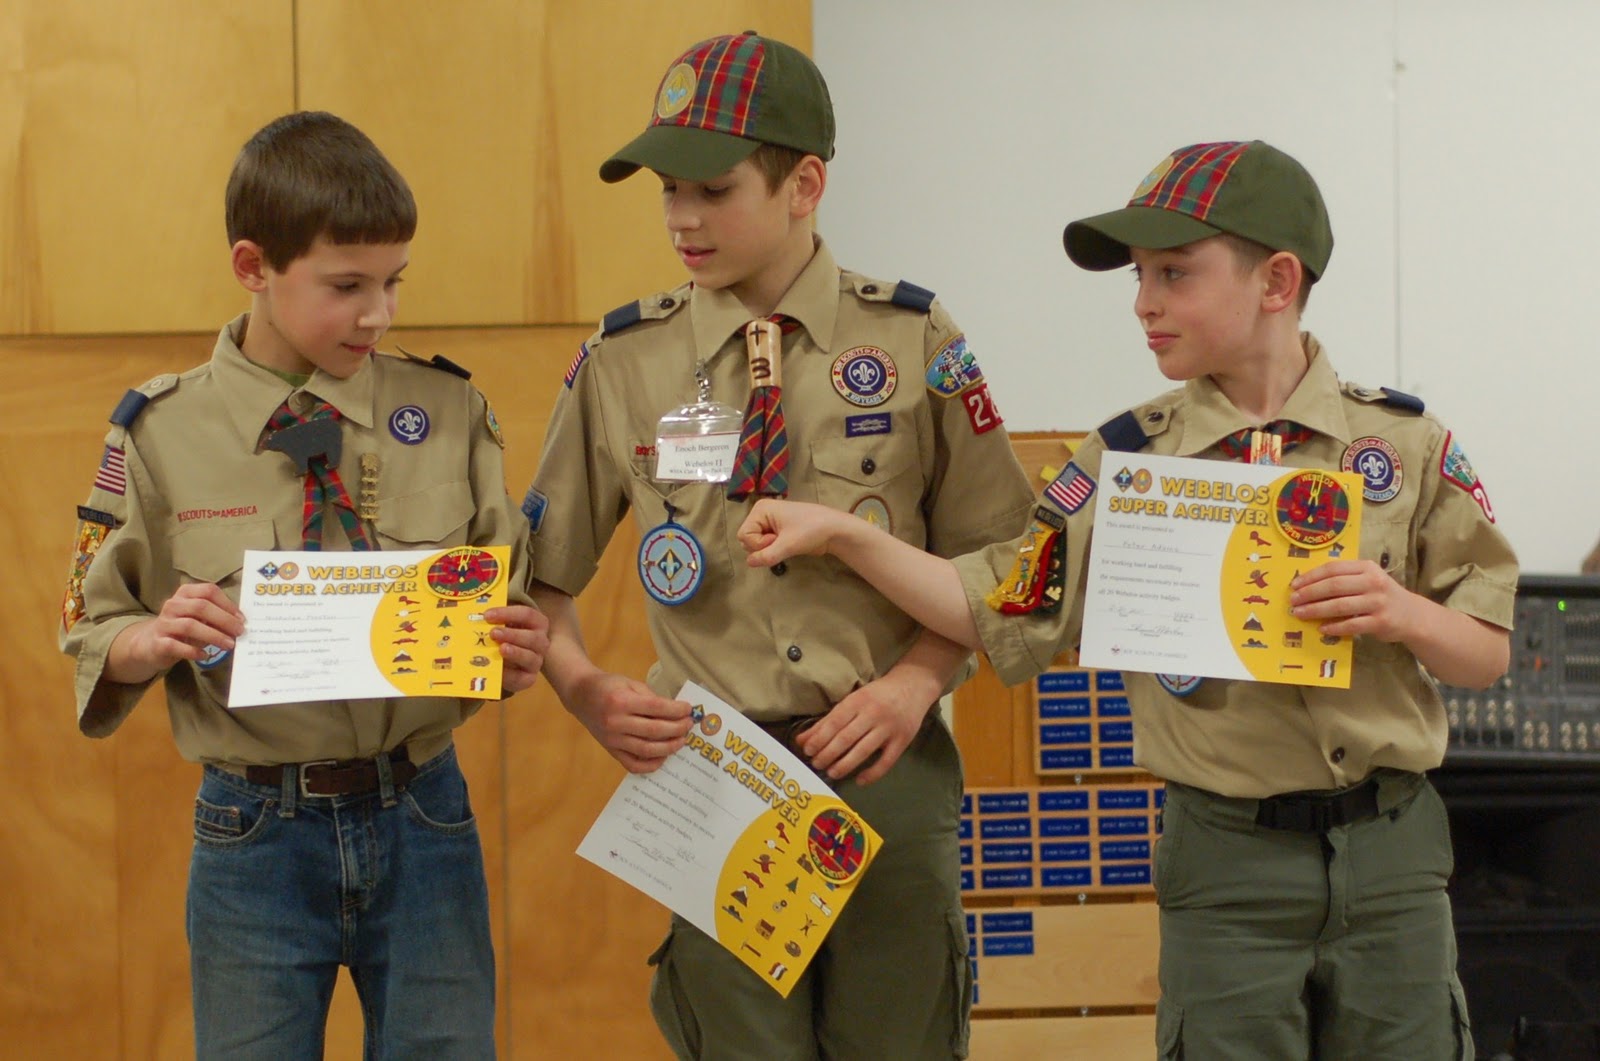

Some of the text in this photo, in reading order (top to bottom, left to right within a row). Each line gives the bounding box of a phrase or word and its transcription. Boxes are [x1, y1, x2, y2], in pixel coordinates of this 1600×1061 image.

[1160, 476, 1270, 505] WEBELOS
[182, 509, 213, 521] SCOUTS
[220, 505, 257, 518] AMERICA
[1109, 496, 1269, 526] SUPER ACHIEVER
[307, 564, 418, 581] WEBELOS
[255, 580, 418, 596] SUPER ACHIEVER
[686, 732, 800, 827] PER ACHIEVER
[724, 729, 812, 809] WEBELOS
